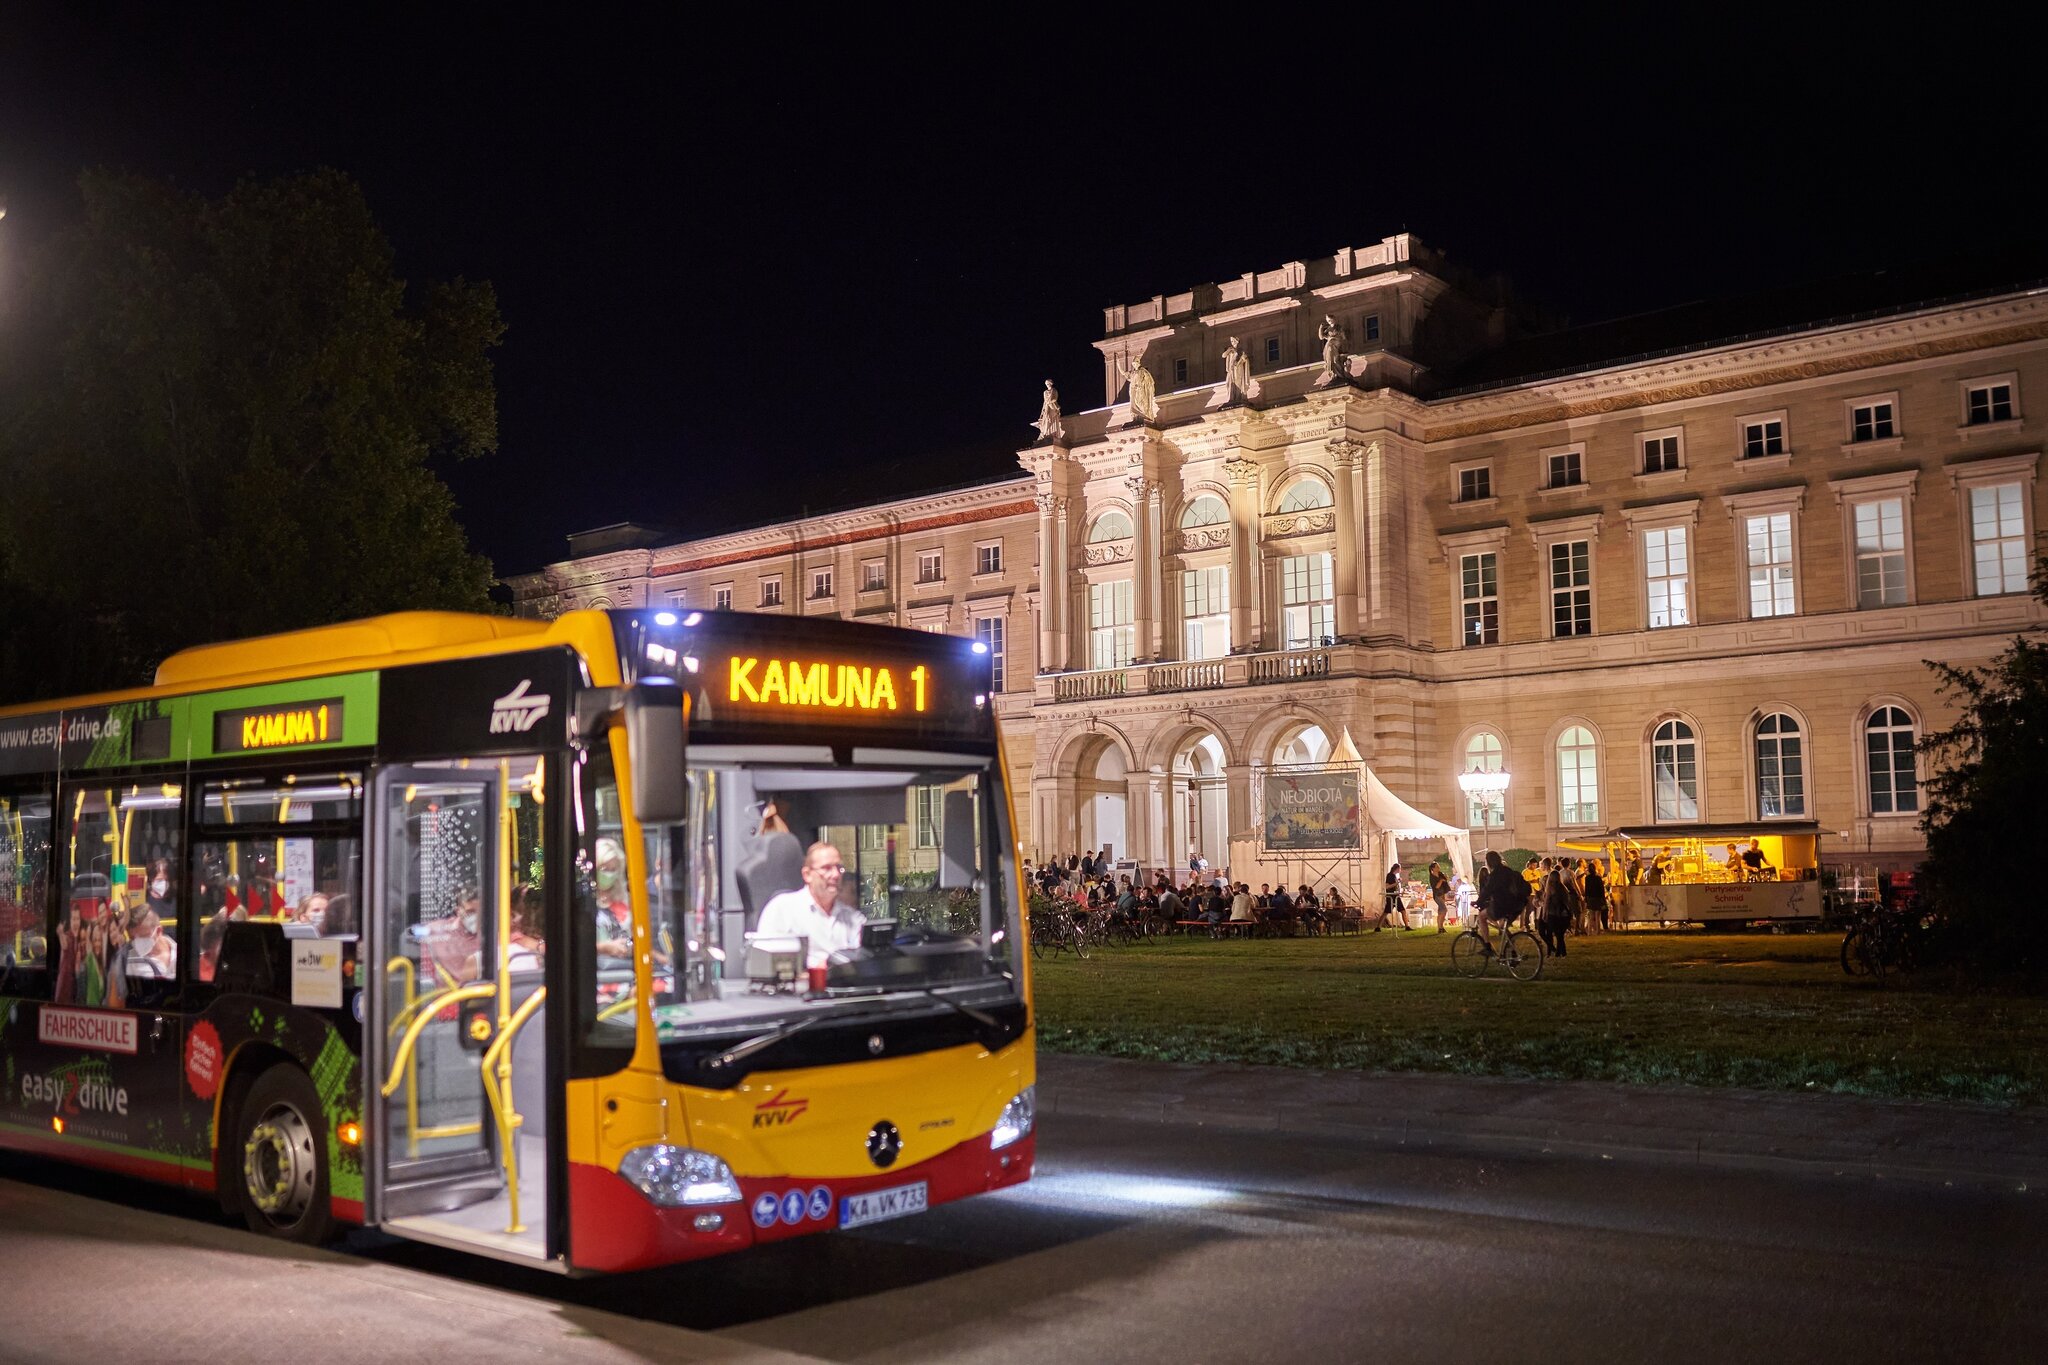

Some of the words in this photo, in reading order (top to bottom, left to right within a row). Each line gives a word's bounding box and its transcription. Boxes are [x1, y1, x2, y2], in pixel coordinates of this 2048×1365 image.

[731, 656, 896, 710] KAMUNA
[911, 665, 925, 711] 1
[0, 713, 121, 749] www.easy2drive.de
[243, 710, 316, 748] KAMUNA
[317, 704, 328, 740] 1
[1280, 787, 1343, 804] NEOBIOTA
[1704, 885, 1752, 893] Partyservice
[1714, 894, 1744, 902] Schmid
[45, 1013, 130, 1045] FAHRSCHULE
[22, 1071, 128, 1115] easy2drive
[753, 1109, 789, 1129] KVV
[901, 1186, 925, 1210] 733
